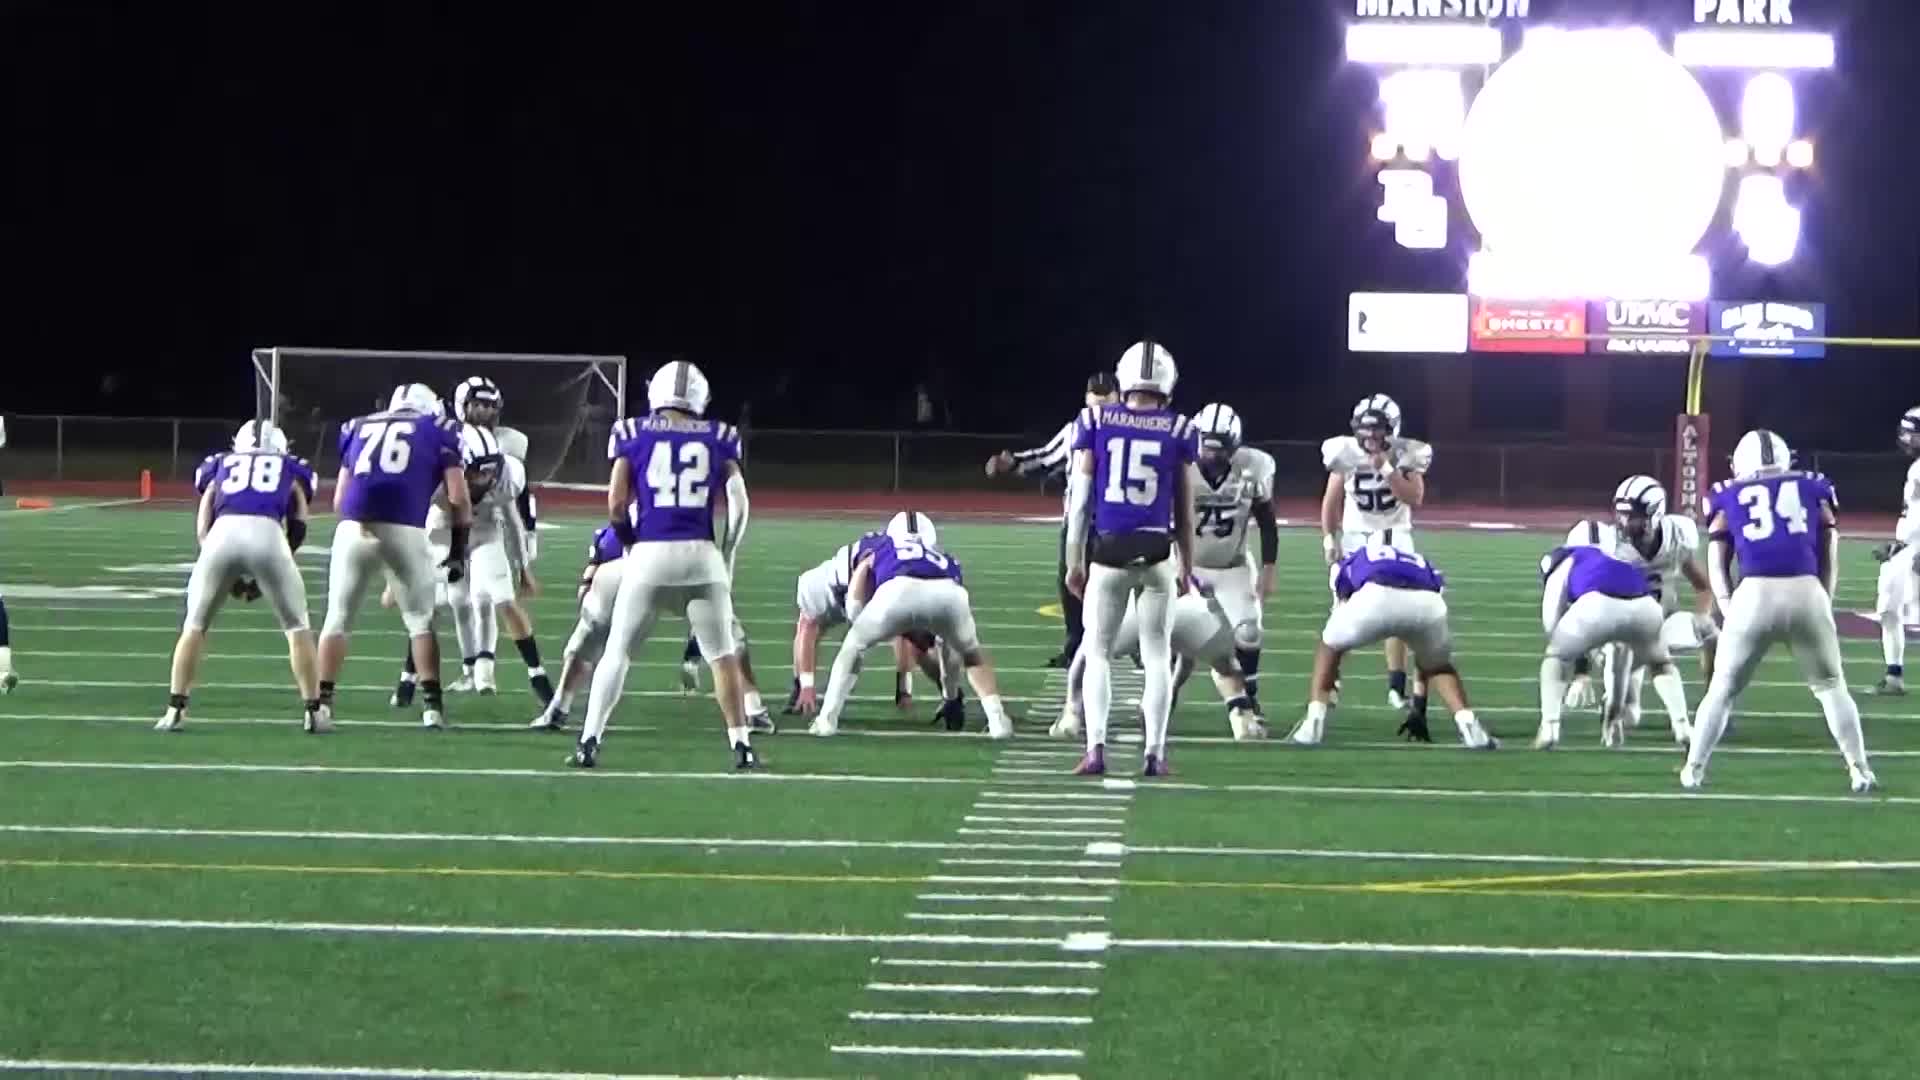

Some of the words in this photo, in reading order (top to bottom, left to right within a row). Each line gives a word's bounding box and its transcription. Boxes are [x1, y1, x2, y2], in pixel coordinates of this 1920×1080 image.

[1694, 0, 1793, 24] PARK
[1605, 300, 1690, 326] UPMC
[354, 421, 416, 475] 76
[1104, 437, 1161, 506] 15
[221, 453, 283, 495] 38
[646, 440, 710, 508] 42
[1196, 505, 1236, 538] 75
[1737, 480, 1809, 541] 34
